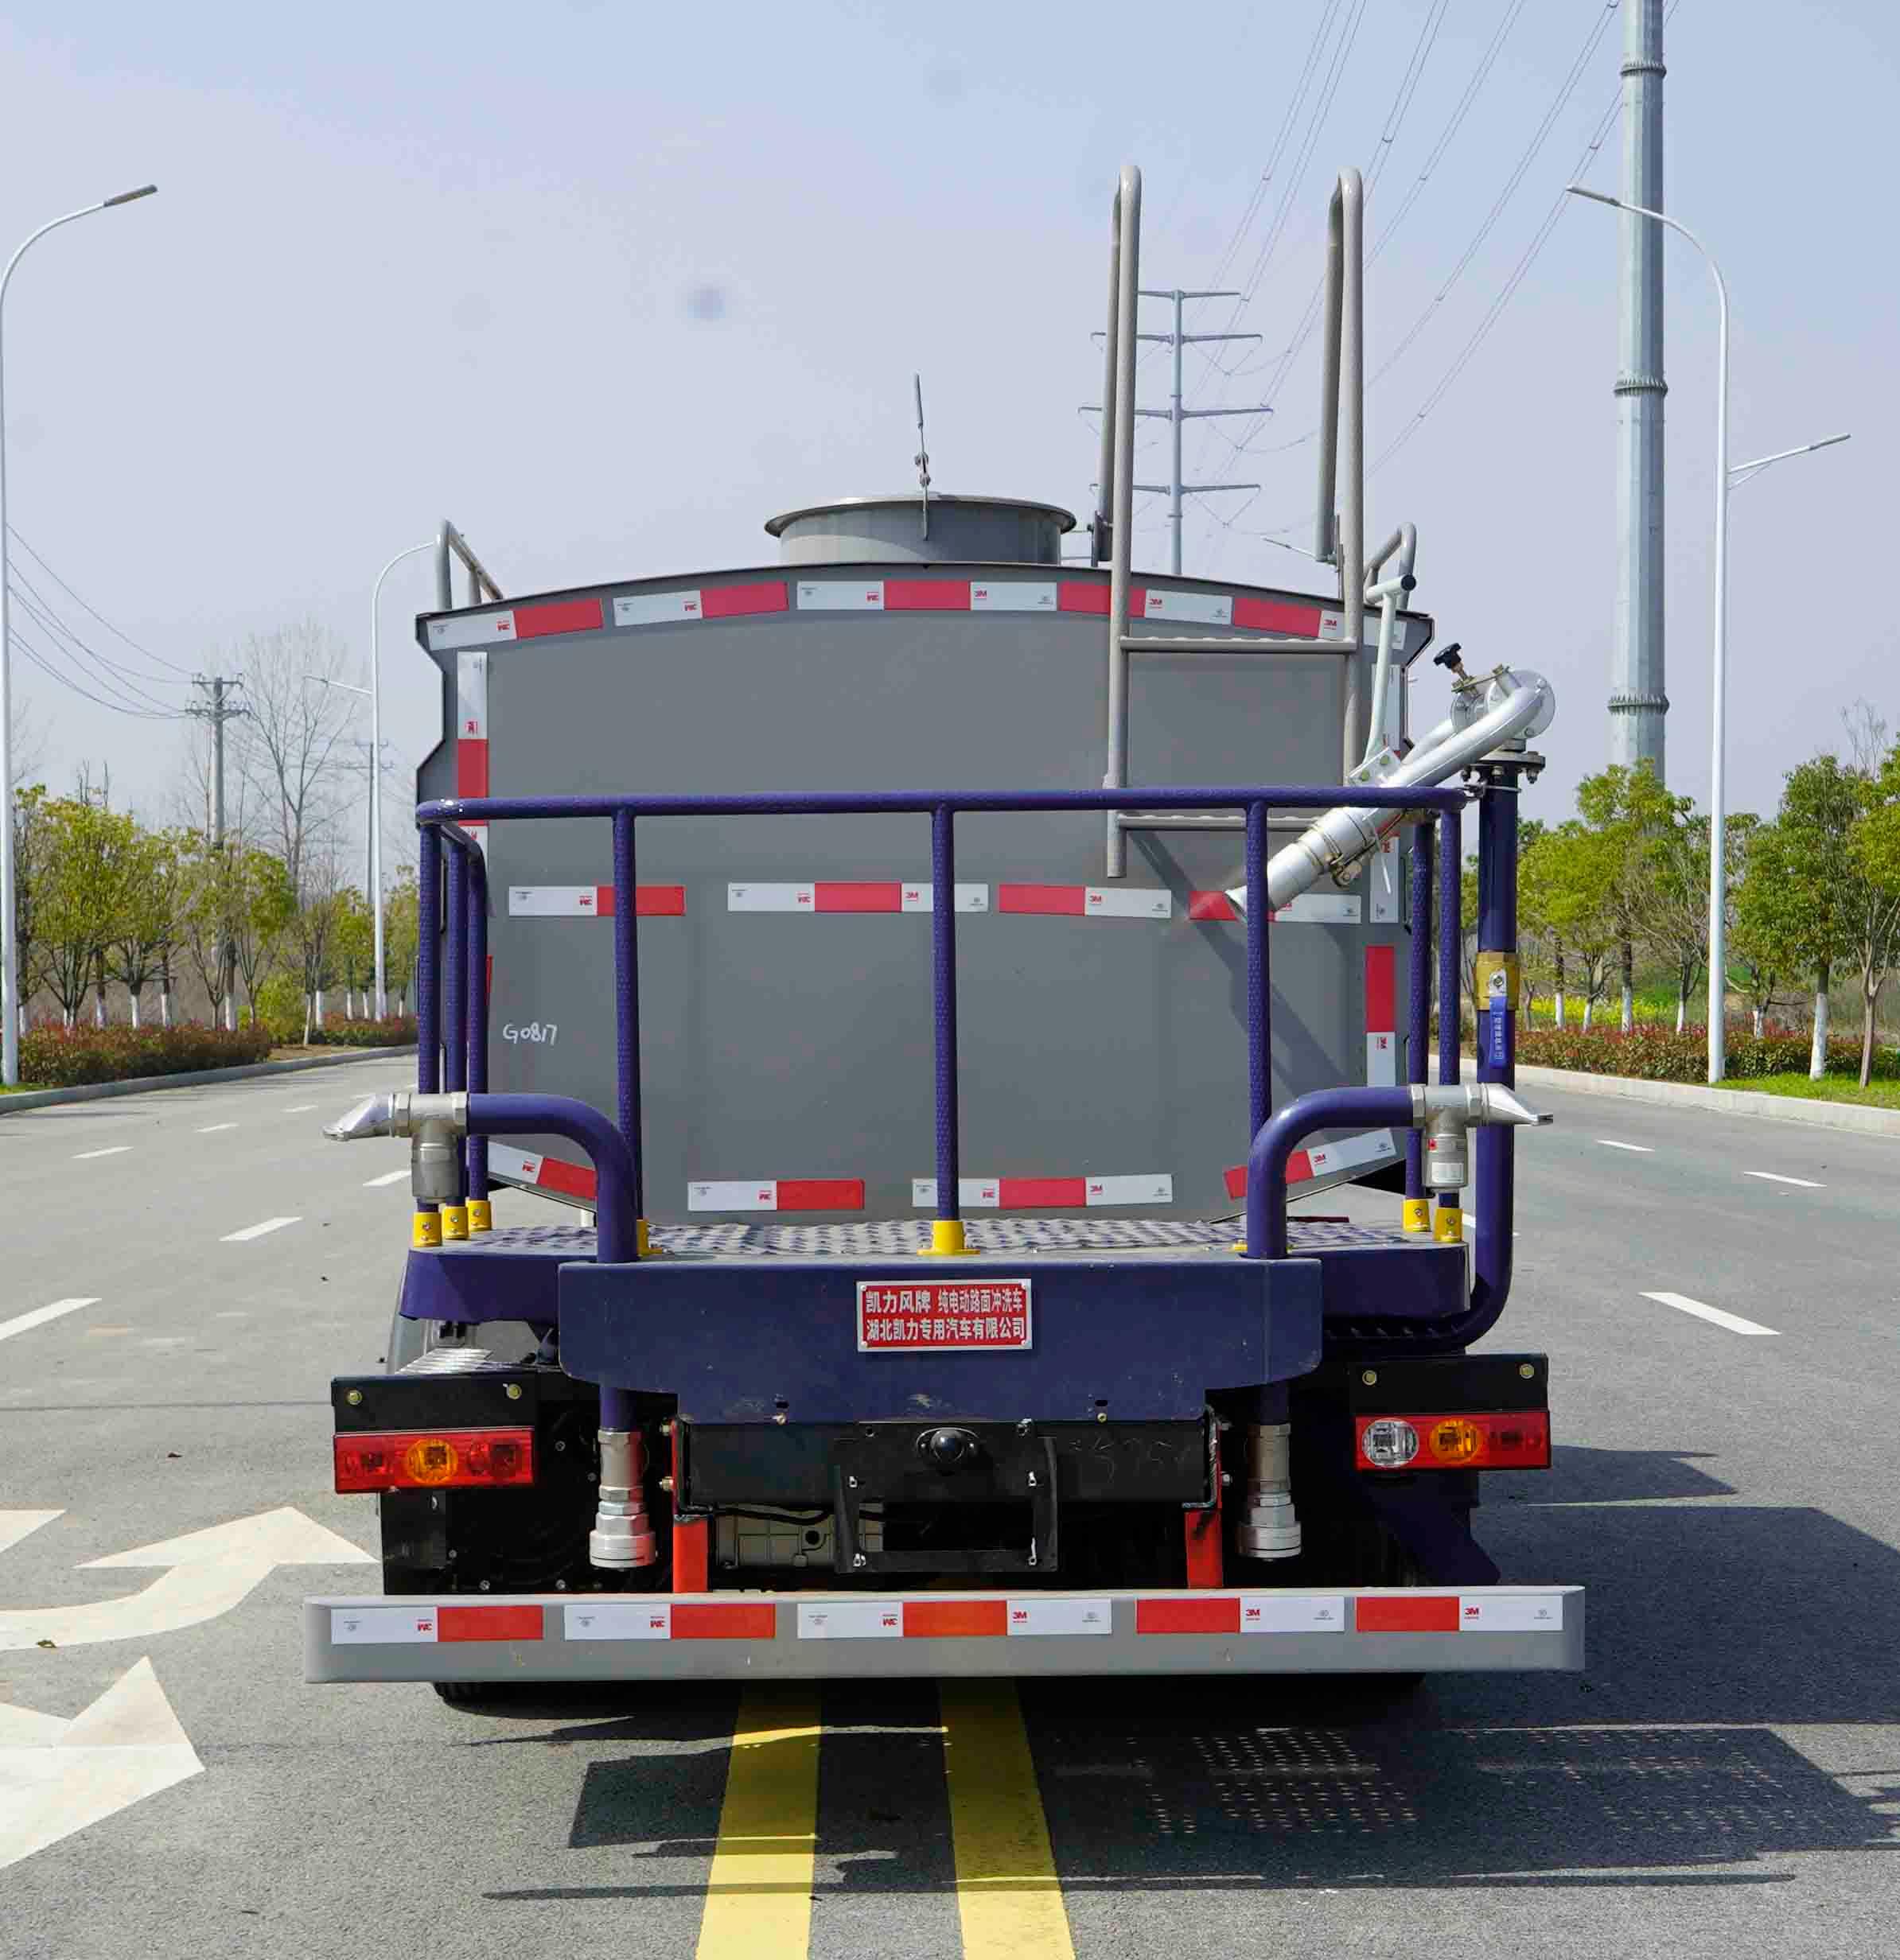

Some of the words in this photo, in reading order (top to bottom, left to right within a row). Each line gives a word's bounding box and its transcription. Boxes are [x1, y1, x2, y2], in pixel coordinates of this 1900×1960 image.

[866, 1289, 931, 1313] 凯力风牌
[938, 1288, 1022, 1312] 纯电动路面冲洗车
[866, 1316, 1025, 1341] 湖北凯力专用汽车有限公司
